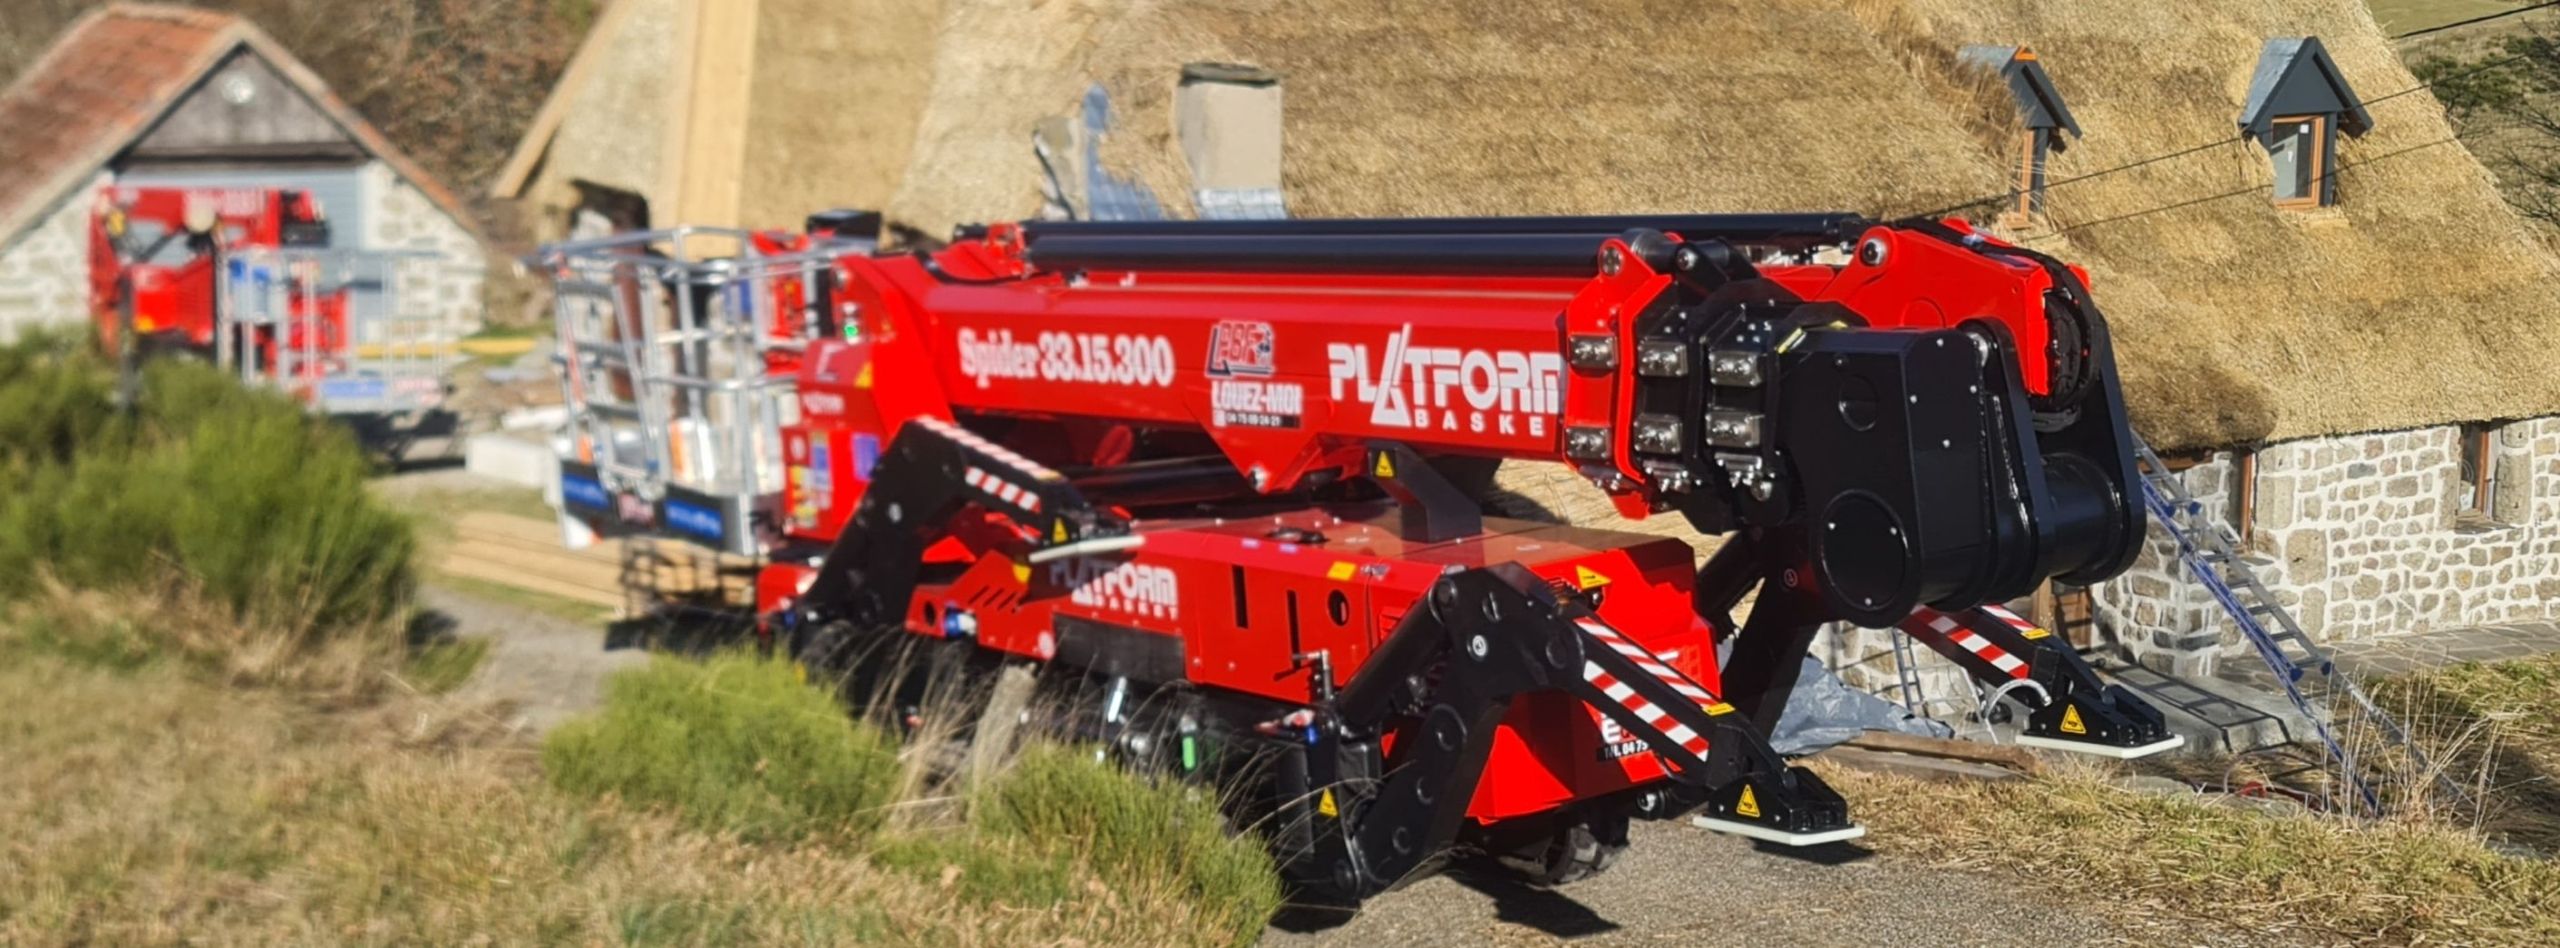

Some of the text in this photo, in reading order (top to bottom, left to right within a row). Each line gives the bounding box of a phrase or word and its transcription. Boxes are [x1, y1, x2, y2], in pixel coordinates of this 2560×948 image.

[957, 327, 1175, 389] Spider 33.15.300
[1328, 323, 1561, 427] PLATFORM
[1211, 380, 1303, 415] LOUEZ-MOI
[1414, 408, 1545, 437] BASKE
